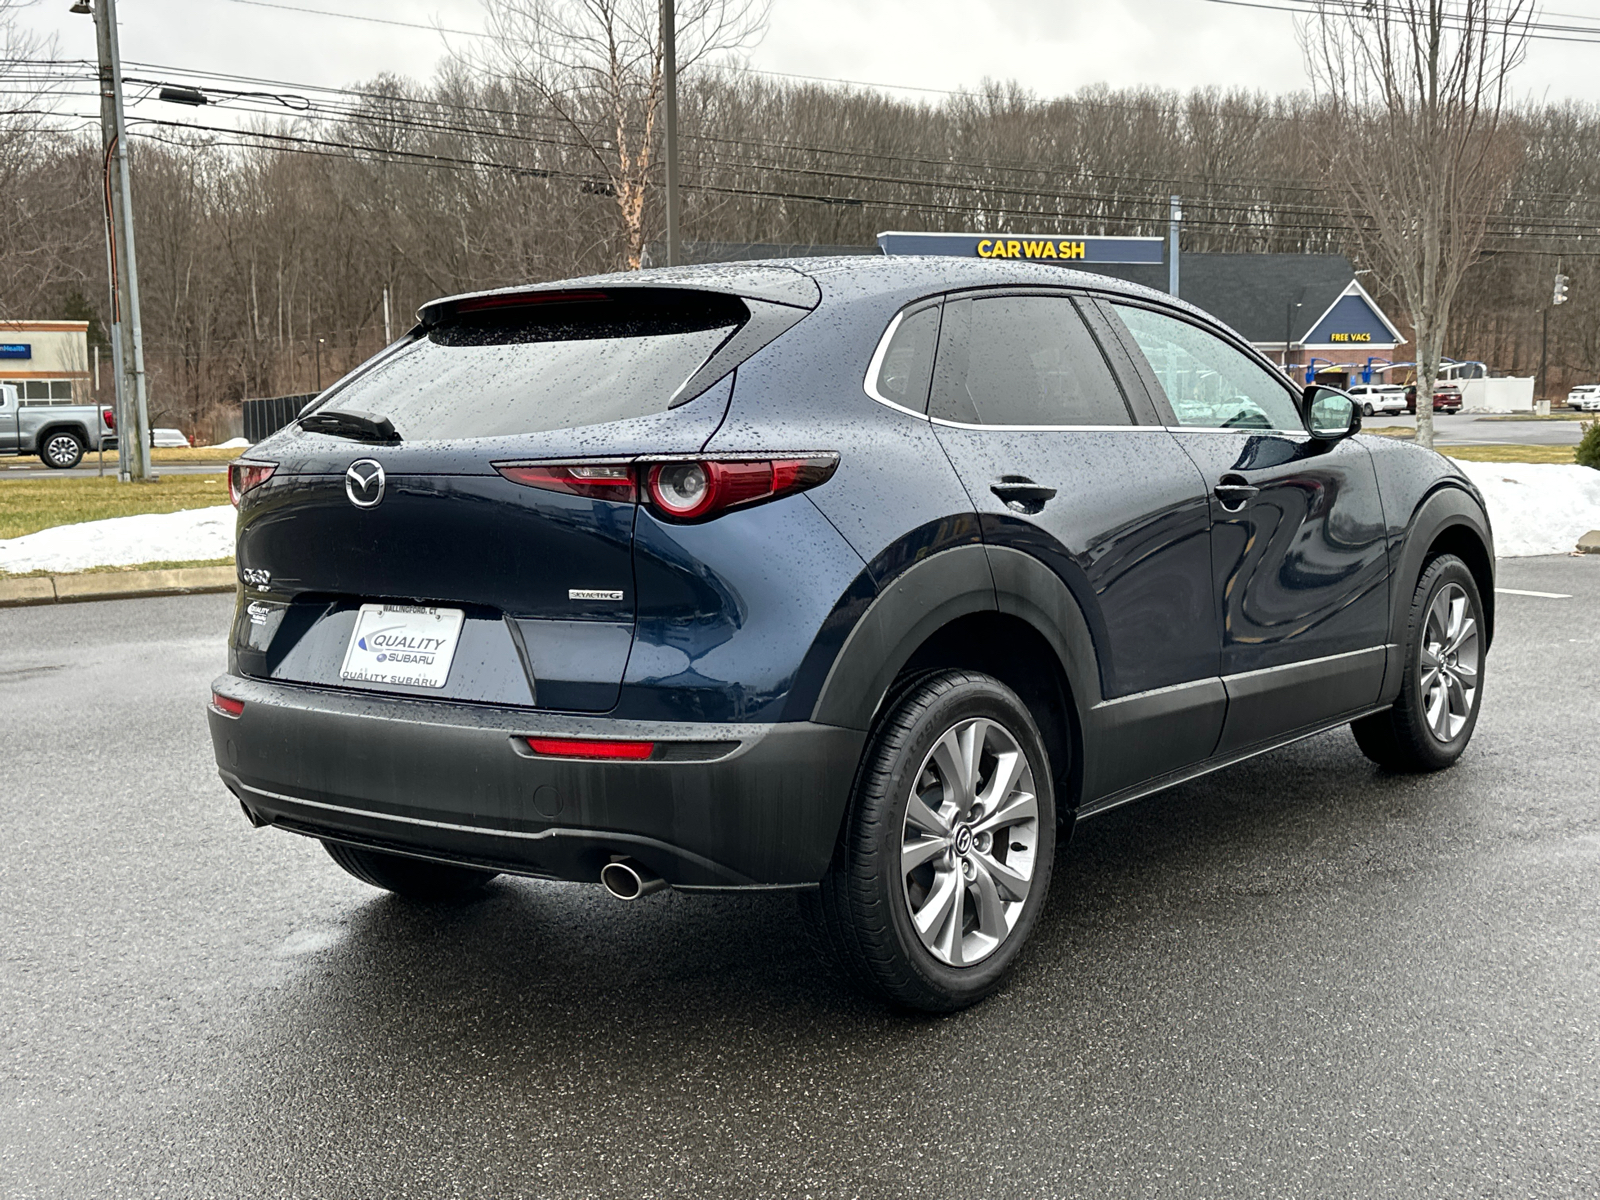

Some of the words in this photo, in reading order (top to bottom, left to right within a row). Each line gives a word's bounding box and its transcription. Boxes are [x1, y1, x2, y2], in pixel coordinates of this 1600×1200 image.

[1331, 333, 1349, 342] FREE
[1350, 333, 1371, 342] VACS
[373, 634, 446, 651] QUALITY
[388, 653, 435, 665] SUBARU
[342, 671, 387, 682] QUALITY
[390, 675, 438, 687] SUBARU
